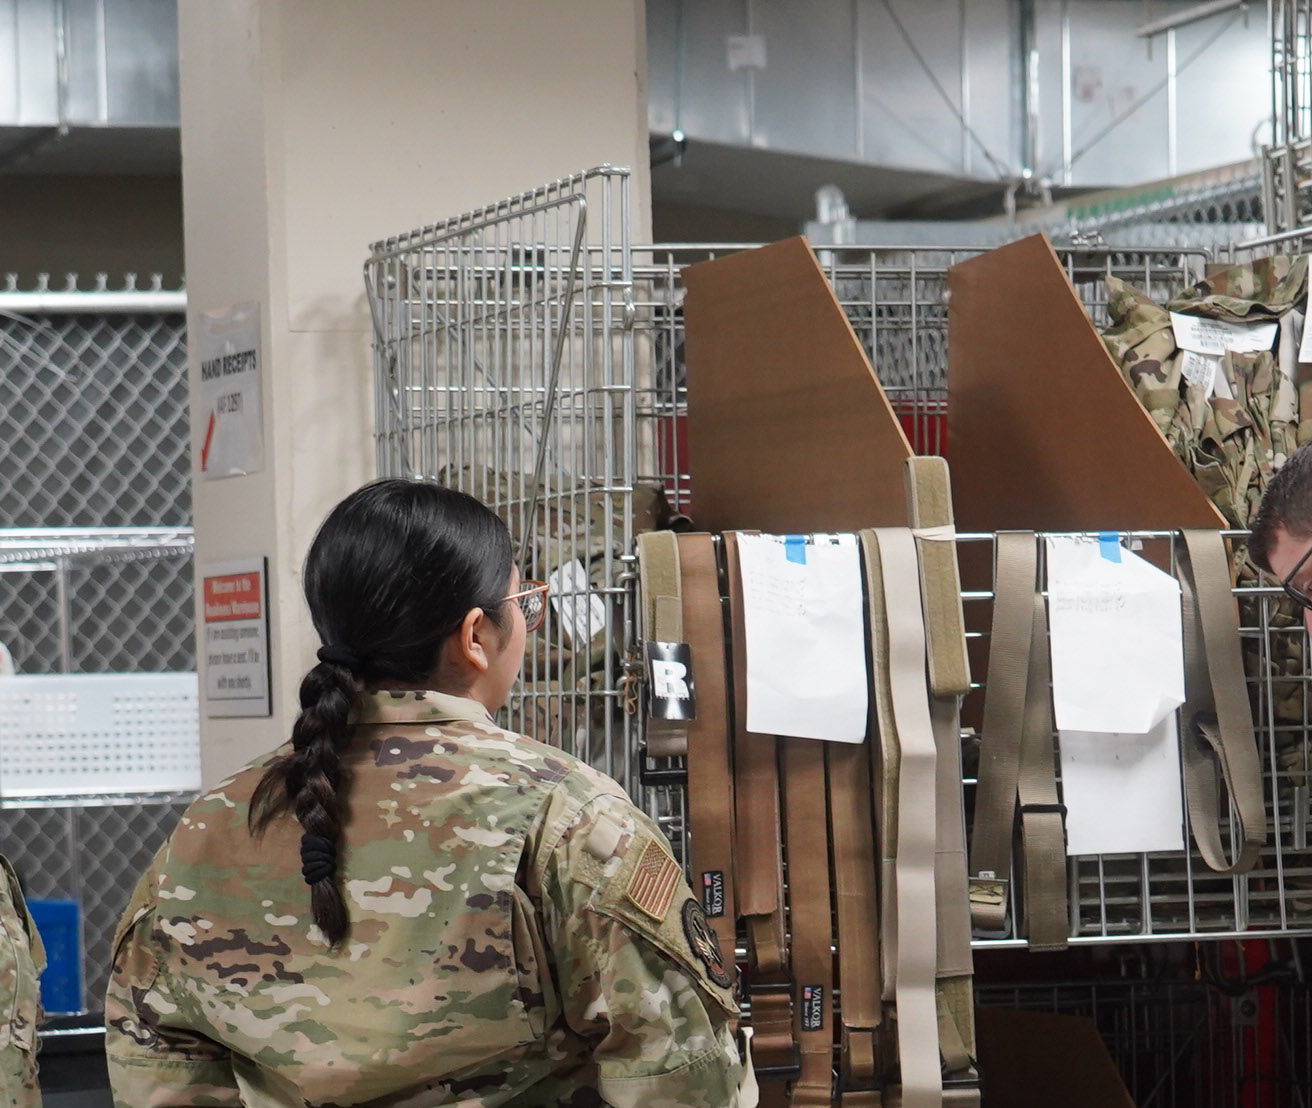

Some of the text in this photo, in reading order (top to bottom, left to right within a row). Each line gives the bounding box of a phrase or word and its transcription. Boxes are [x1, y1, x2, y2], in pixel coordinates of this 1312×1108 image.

[201, 349, 257, 382] HAND RECEIPTS
[711, 873, 723, 915] VALKOR
[810, 987, 822, 1029] VALKOR
